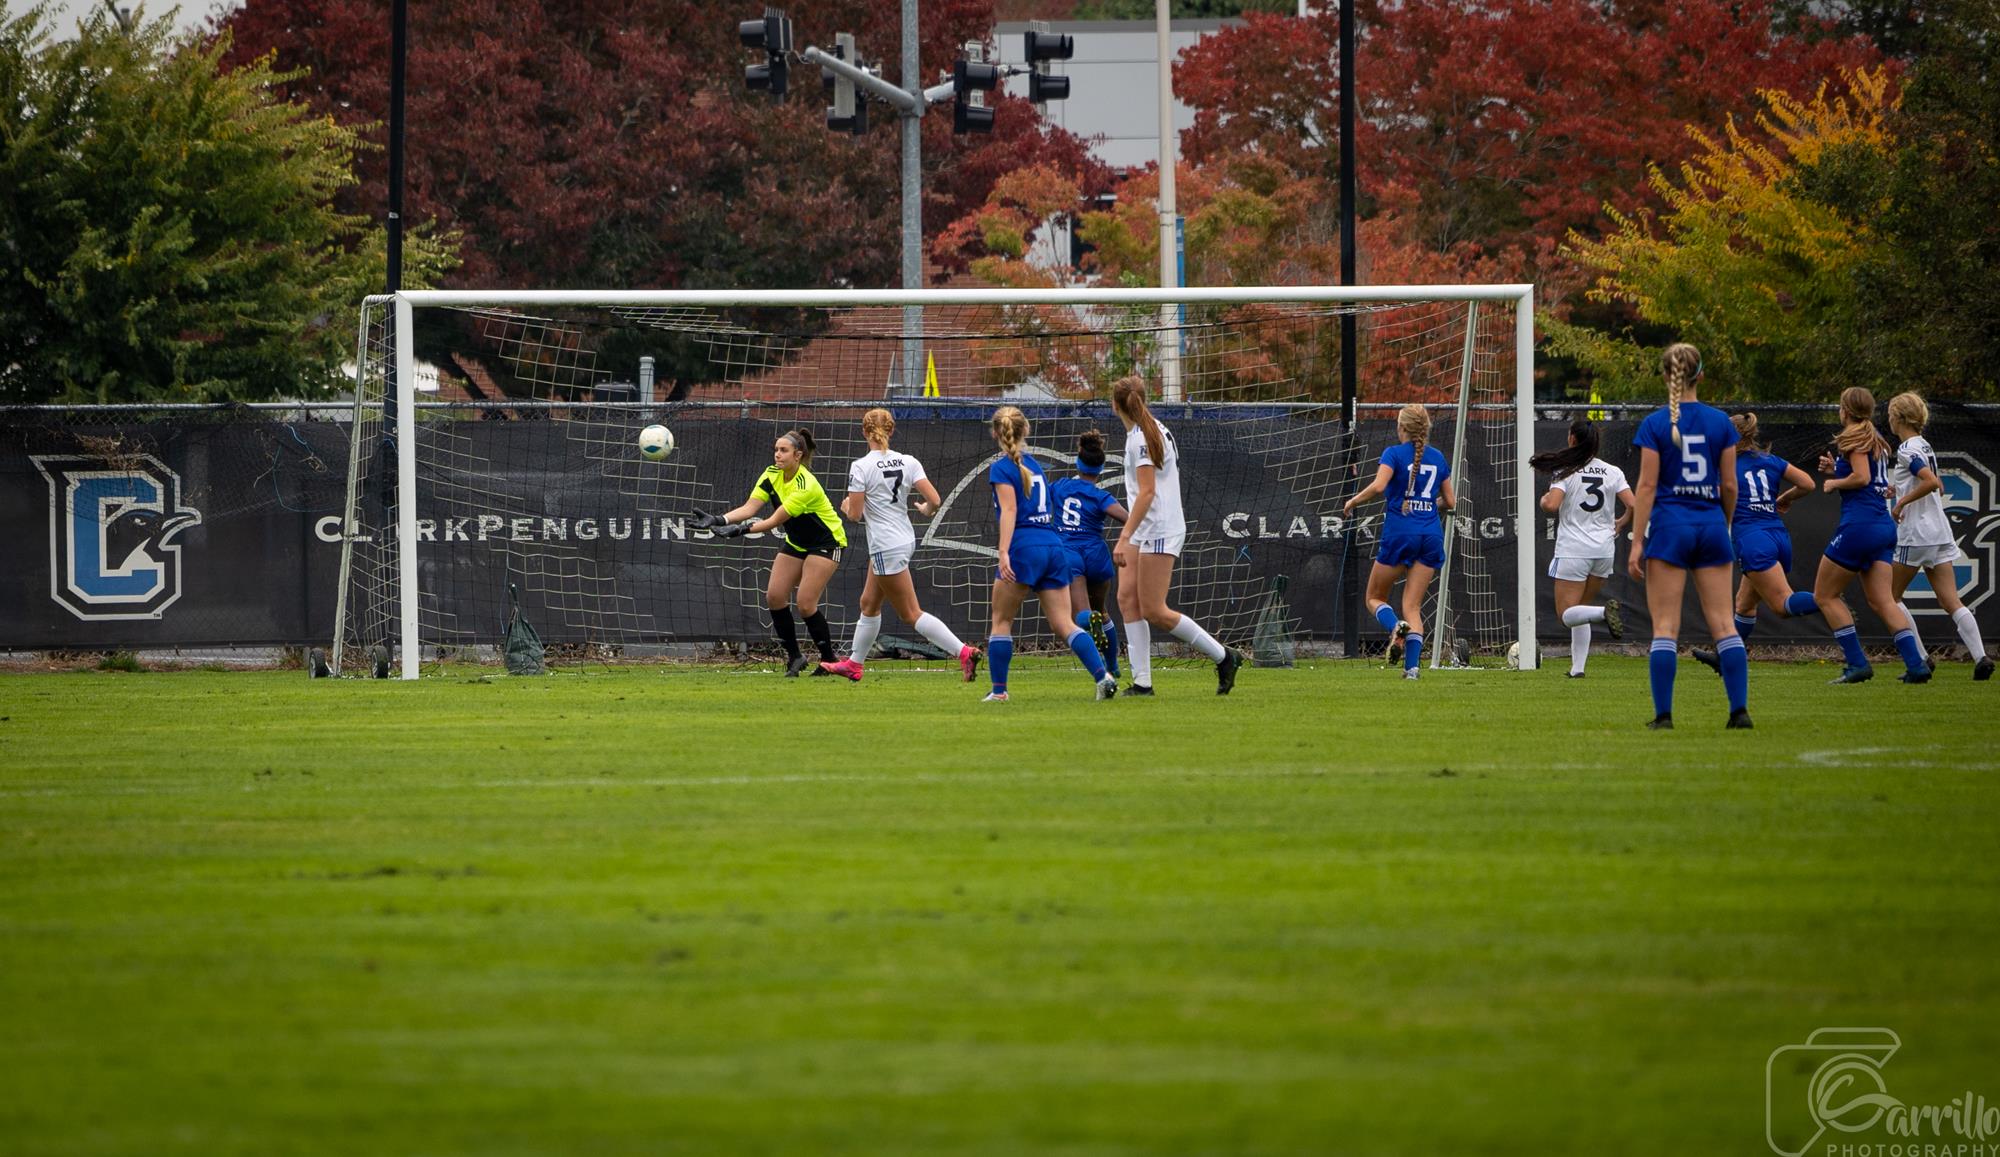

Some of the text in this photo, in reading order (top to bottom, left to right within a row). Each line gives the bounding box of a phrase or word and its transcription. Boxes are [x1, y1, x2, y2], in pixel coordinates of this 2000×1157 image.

[877, 459, 904, 469] CLARK
[1682, 434, 1707, 482] 5
[883, 470, 903, 504] 7
[1405, 463, 1437, 498] 17
[1579, 476, 1604, 512] 3
[1745, 469, 1771, 502] 11
[1062, 497, 1082, 526] 6
